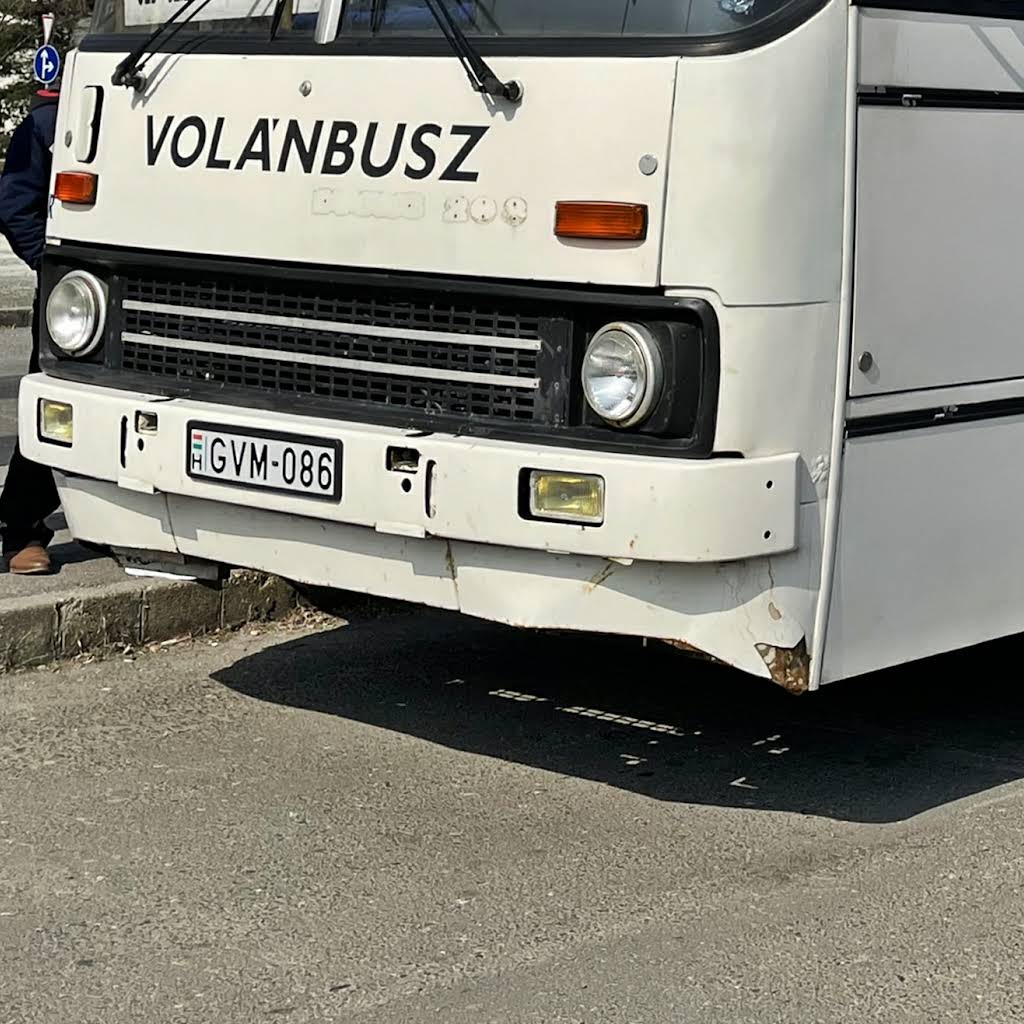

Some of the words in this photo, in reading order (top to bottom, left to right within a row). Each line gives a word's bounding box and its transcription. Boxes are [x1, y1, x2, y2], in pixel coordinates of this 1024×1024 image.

[146, 114, 491, 182] VOLÁNBUSZ
[192, 453, 202, 471] H
[210, 437, 332, 490] GVM-086
